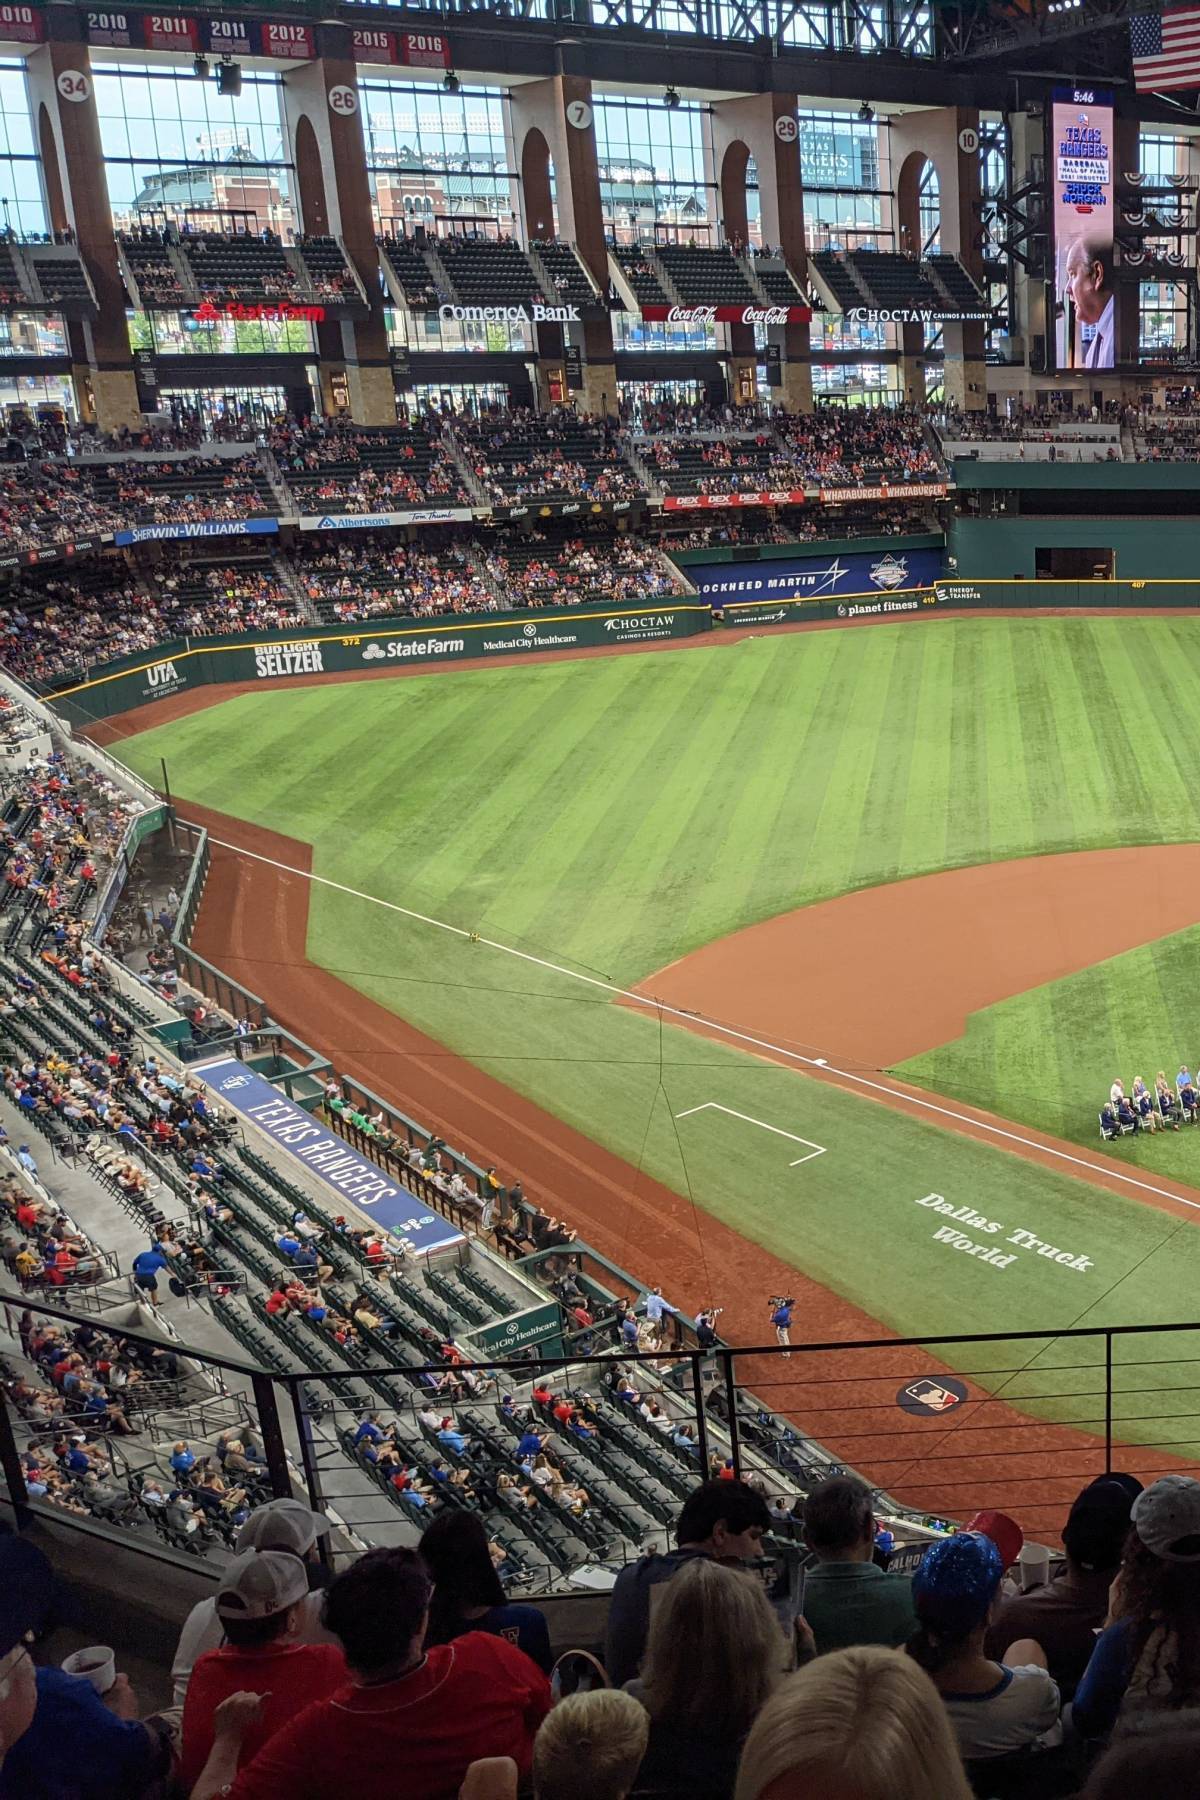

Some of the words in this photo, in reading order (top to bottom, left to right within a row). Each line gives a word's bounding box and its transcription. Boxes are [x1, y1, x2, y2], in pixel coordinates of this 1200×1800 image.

[87, 13, 127, 30] 2010
[152, 17, 188, 34] 2011
[211, 21, 246, 38] 2011
[269, 25, 306, 42] 2012
[353, 31, 388, 48] 2015
[408, 35, 442, 52] 2016
[61, 77, 87, 95] 34
[331, 92, 354, 109] 26
[1073, 91, 1094, 104] 5:46
[574, 106, 585, 122] 7
[778, 121, 796, 137] 29
[1066, 126, 1102, 142] TEXAS
[802, 141, 829, 150] EXAS
[963, 133, 975, 149] 10
[1059, 141, 1108, 158] RANGERS
[1066, 183, 1102, 195] CHUCK
[1062, 193, 1107, 206] MORGAN
[533, 305, 581, 322] Bank
[856, 308, 932, 322] CHOCTAW
[708, 495, 730, 503] DEX
[739, 493, 760, 502] DEX
[769, 492, 791, 500] DEX
[823, 488, 882, 501] WHATABURGER
[886, 485, 943, 497] WHATABURGER
[677, 496, 699, 505] DEX
[338, 517, 390, 529] Albertsons
[38, 550, 57, 559] TOYOTA
[75, 542, 93, 551] TOYOTA
[768, 576, 815, 588] MARTIN
[848, 604, 882, 617] planet
[882, 600, 918, 611] fitness
[611, 616, 674, 630] CHOCTAW
[254, 645, 282, 655] BUD
[283, 641, 320, 653] LIGHT
[342, 638, 360, 647] 372
[484, 638, 515, 650] Medical
[515, 637, 533, 649] City
[534, 634, 577, 647] Healthcare
[255, 650, 325, 678] SELTZER
[147, 661, 178, 686] UTA
[247, 1098, 321, 1144] TEXAS
[297, 1139, 397, 1206] RANGERS
[914, 1192, 1004, 1233] Dallas
[1005, 1228, 1095, 1272] Truck
[931, 1225, 1018, 1269] World
[499, 1335, 516, 1348] City
[516, 1320, 558, 1341] Healthcare
